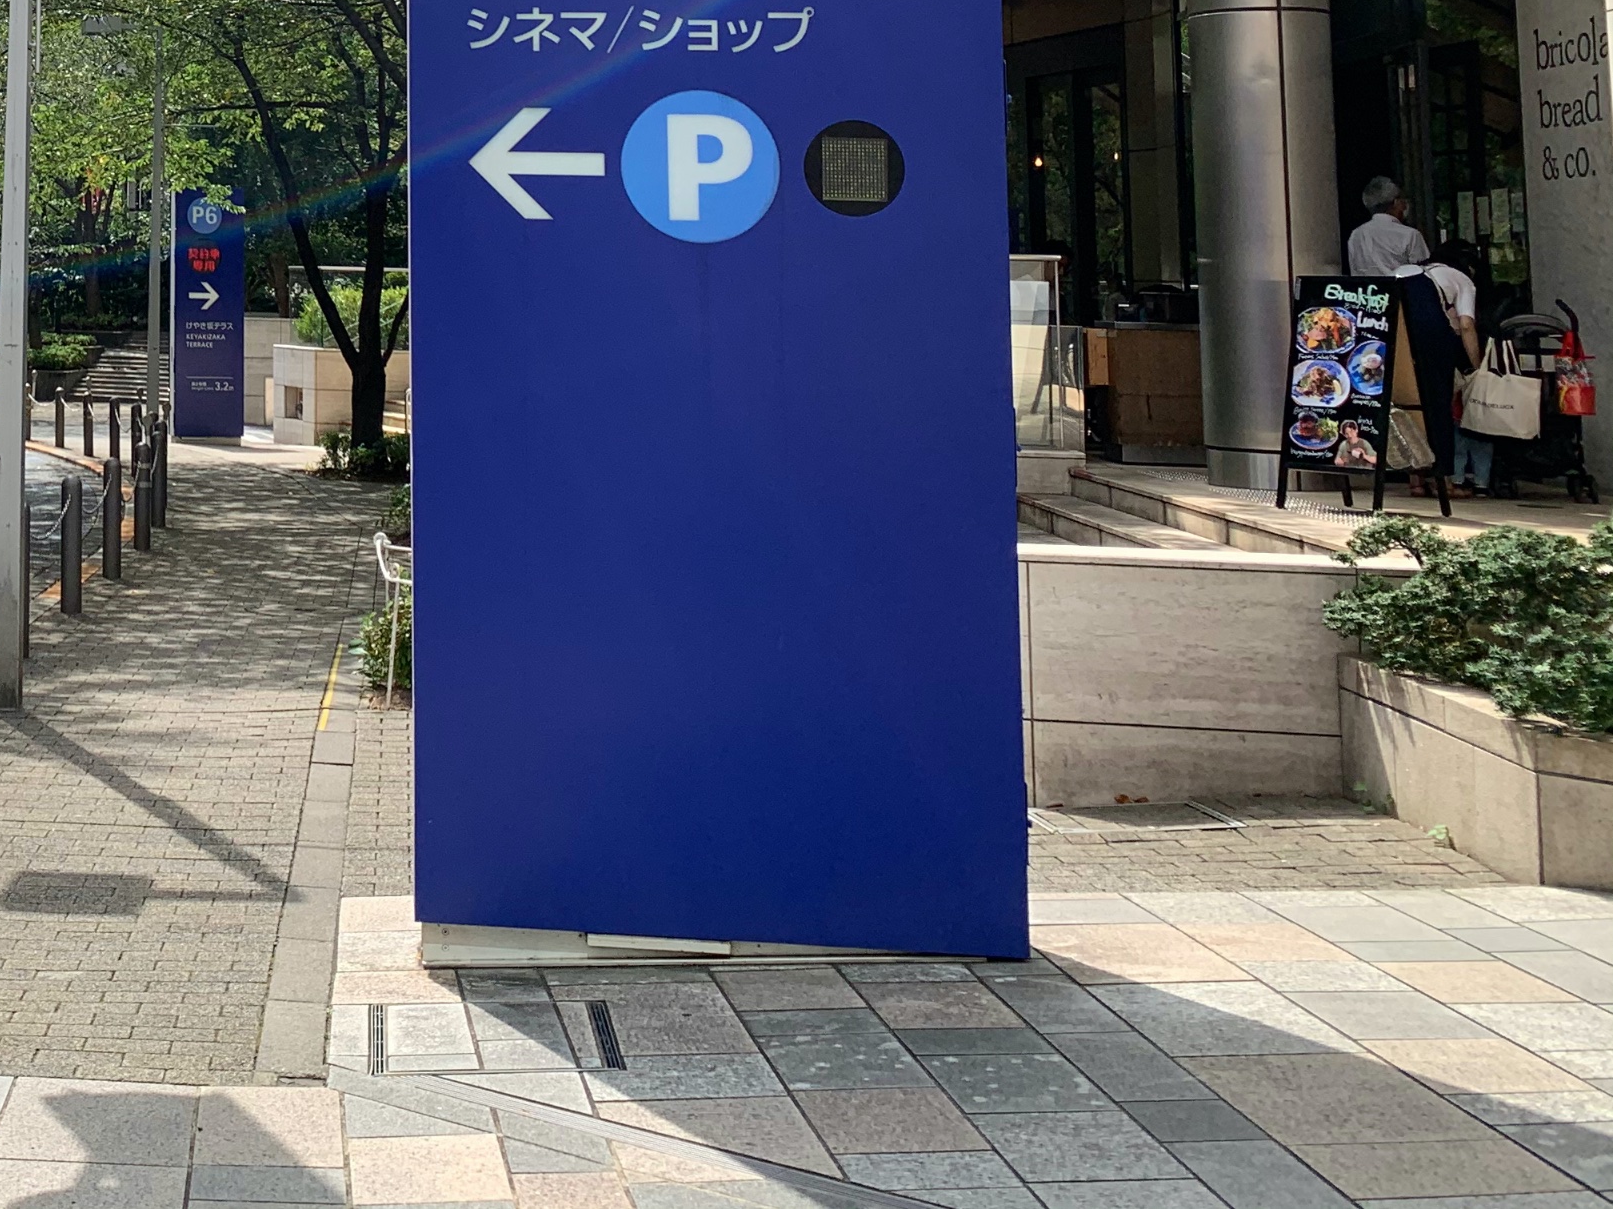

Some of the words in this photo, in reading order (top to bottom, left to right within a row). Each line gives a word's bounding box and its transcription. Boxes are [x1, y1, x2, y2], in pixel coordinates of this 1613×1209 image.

[466, 5, 815, 53] シネマ/ショップ
[1537, 73, 1603, 129] bread
[666, 113, 754, 221] P
[1542, 145, 1559, 181] &
[192, 206, 217, 224] P6
[1356, 311, 1389, 332] Lunch
